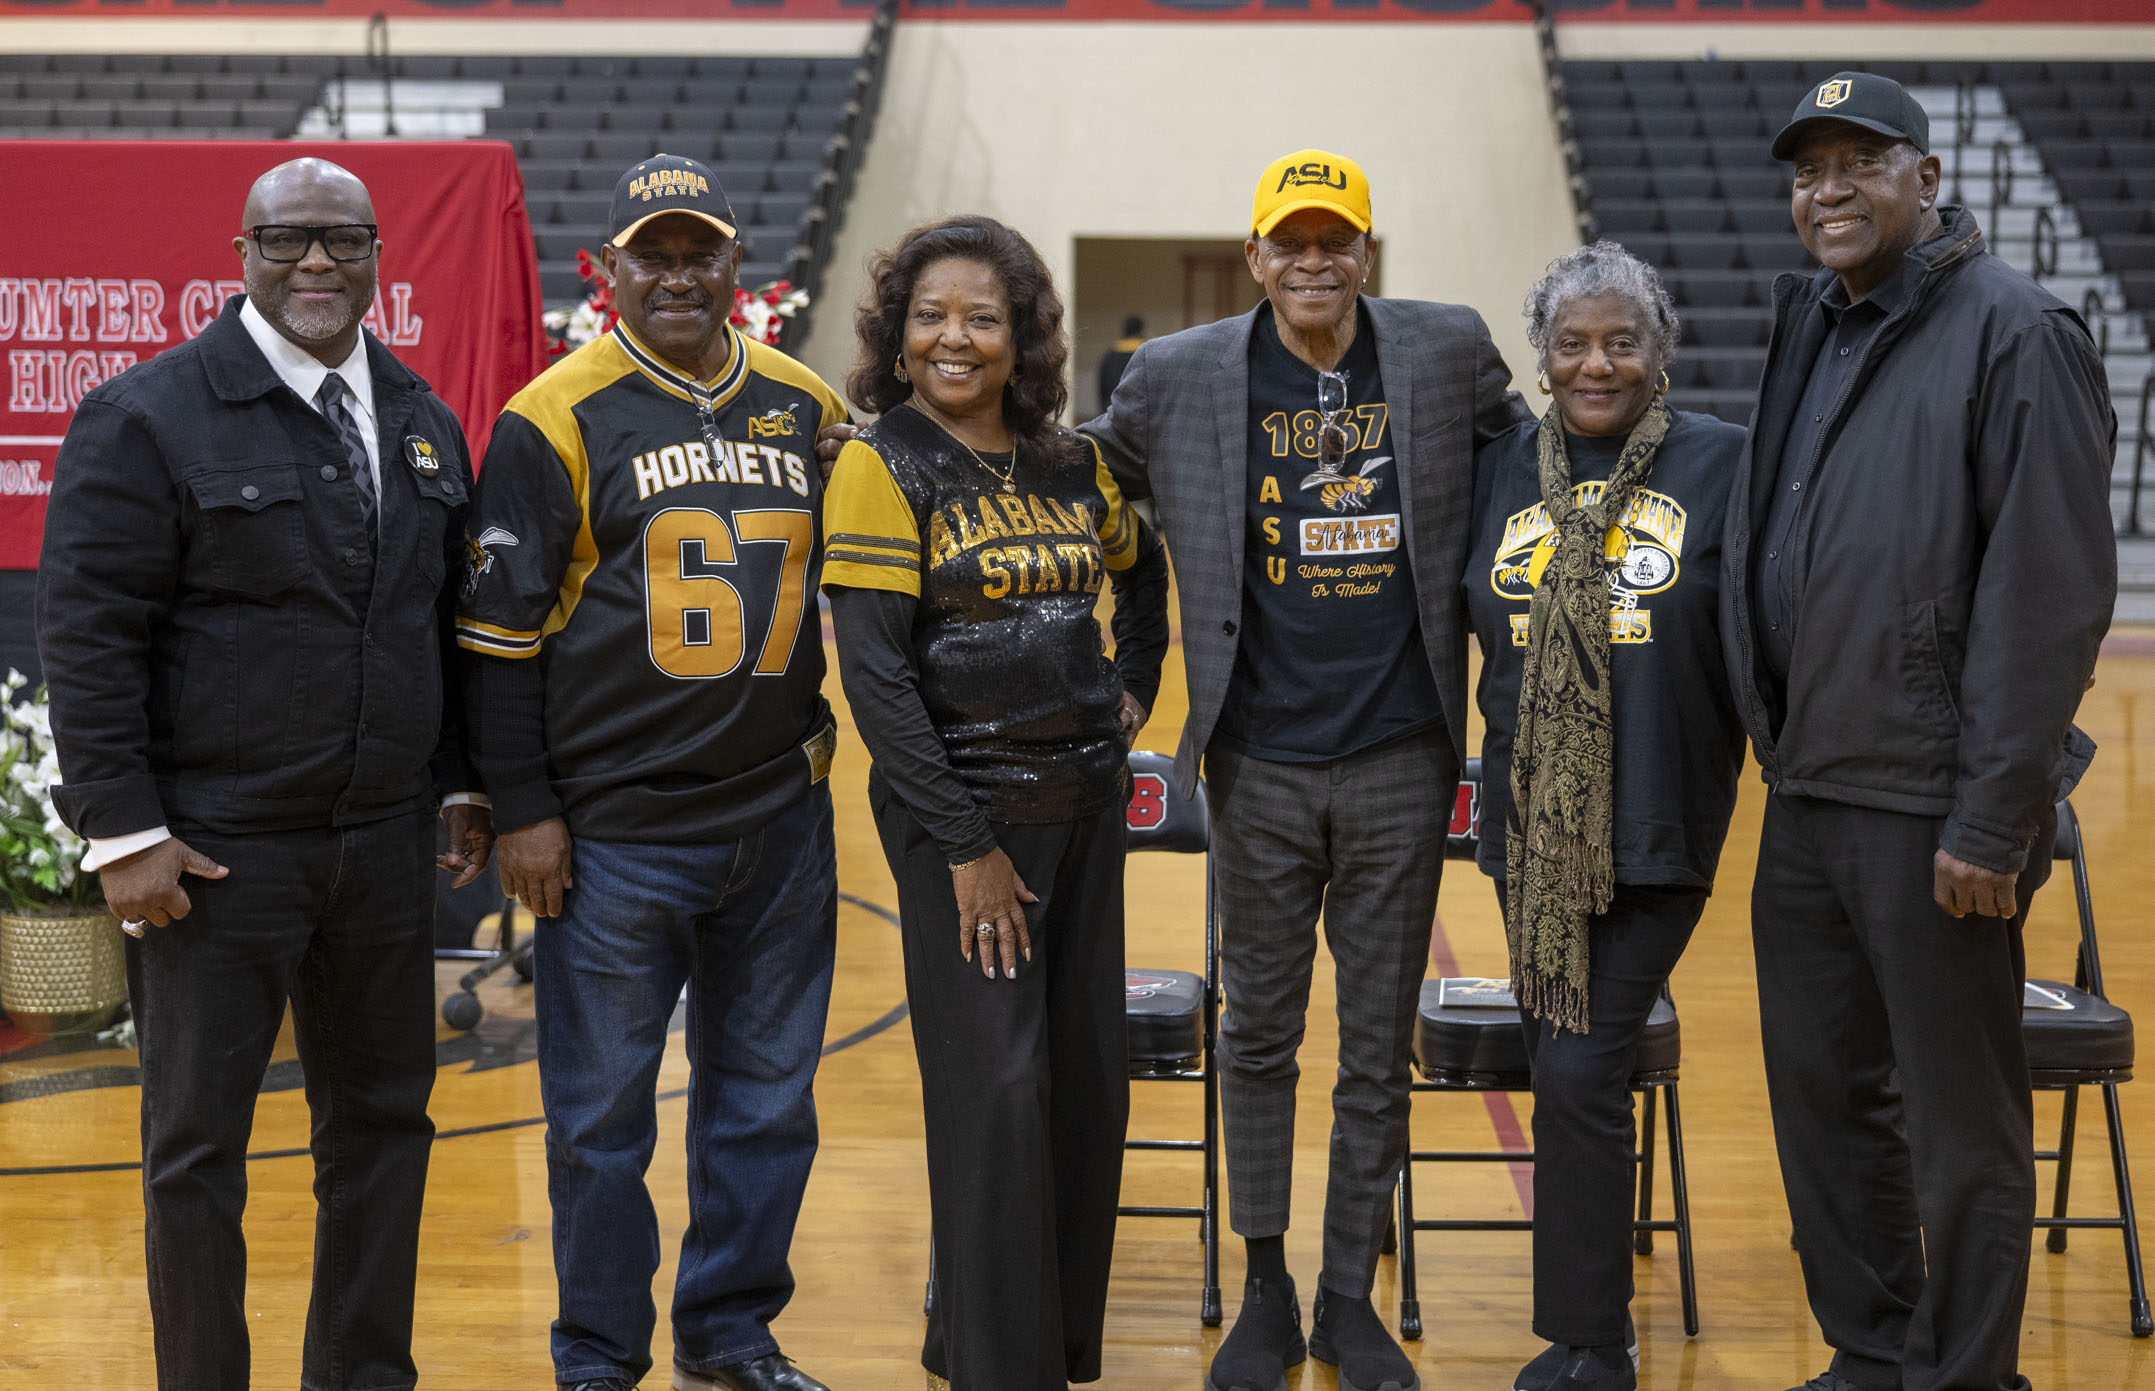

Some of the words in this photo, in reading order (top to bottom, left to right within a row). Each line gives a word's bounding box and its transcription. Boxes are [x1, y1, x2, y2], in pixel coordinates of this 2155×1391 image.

[629, 170, 709, 199] ALABAMA
[1275, 163, 1346, 193] ASU
[642, 185, 698, 201] STATE
[748, 416, 794, 439] ASU
[416, 456, 439, 469] ASU
[632, 441, 809, 500] HORNETS
[1305, 518, 1395, 551] STATE
[1315, 523, 1386, 550] Alabama
[979, 543, 1106, 600] STATE
[1297, 564, 1343, 578] Where
[1346, 563, 1395, 579] History
[644, 507, 813, 679] 67
[1312, 583, 1330, 598] Is
[1335, 580, 1381, 598] Made!
